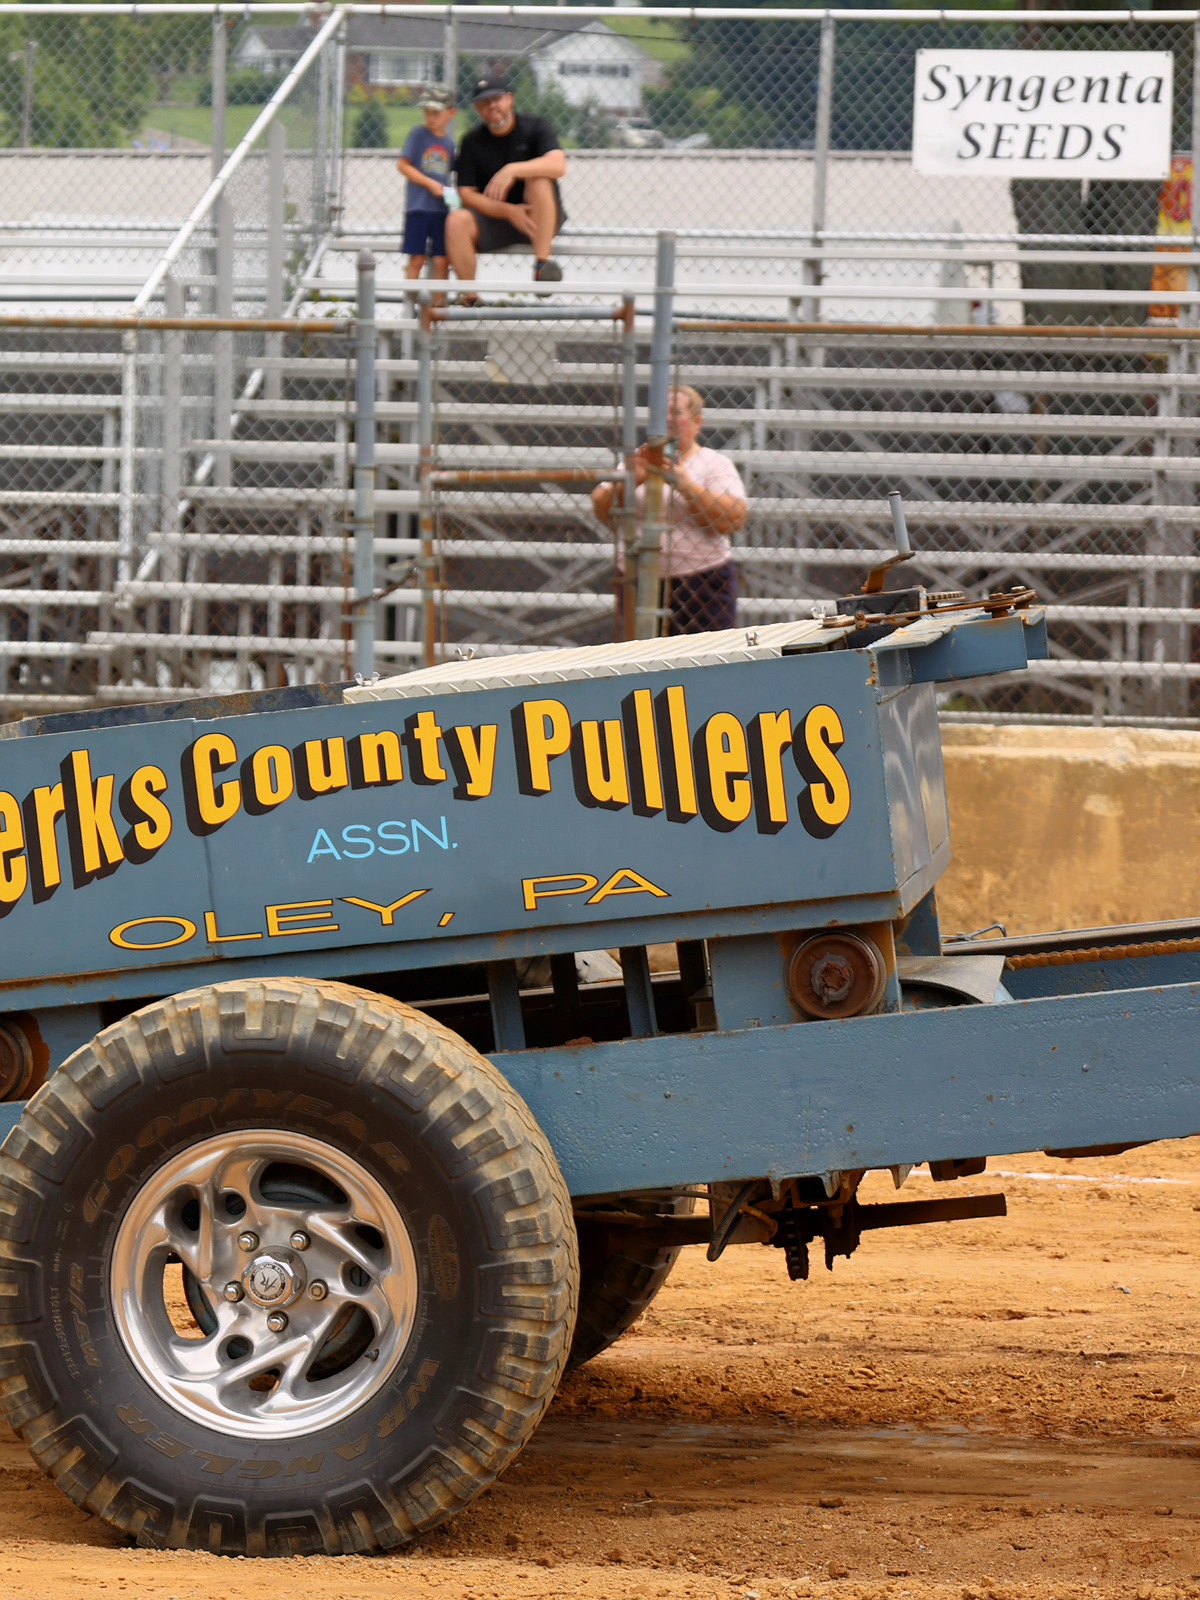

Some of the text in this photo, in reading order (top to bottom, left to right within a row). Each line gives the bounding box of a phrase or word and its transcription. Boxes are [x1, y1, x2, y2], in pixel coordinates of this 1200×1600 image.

[922, 64, 1164, 112] Syngenta
[956, 122, 1127, 161] SEEDS
[181, 710, 498, 836] County
[512, 684, 852, 838] Pullers
[306, 815, 458, 864] ASSN.
[108, 867, 670, 950] OLEY, PA
[115, 1358, 442, 1479] WRANGLER
